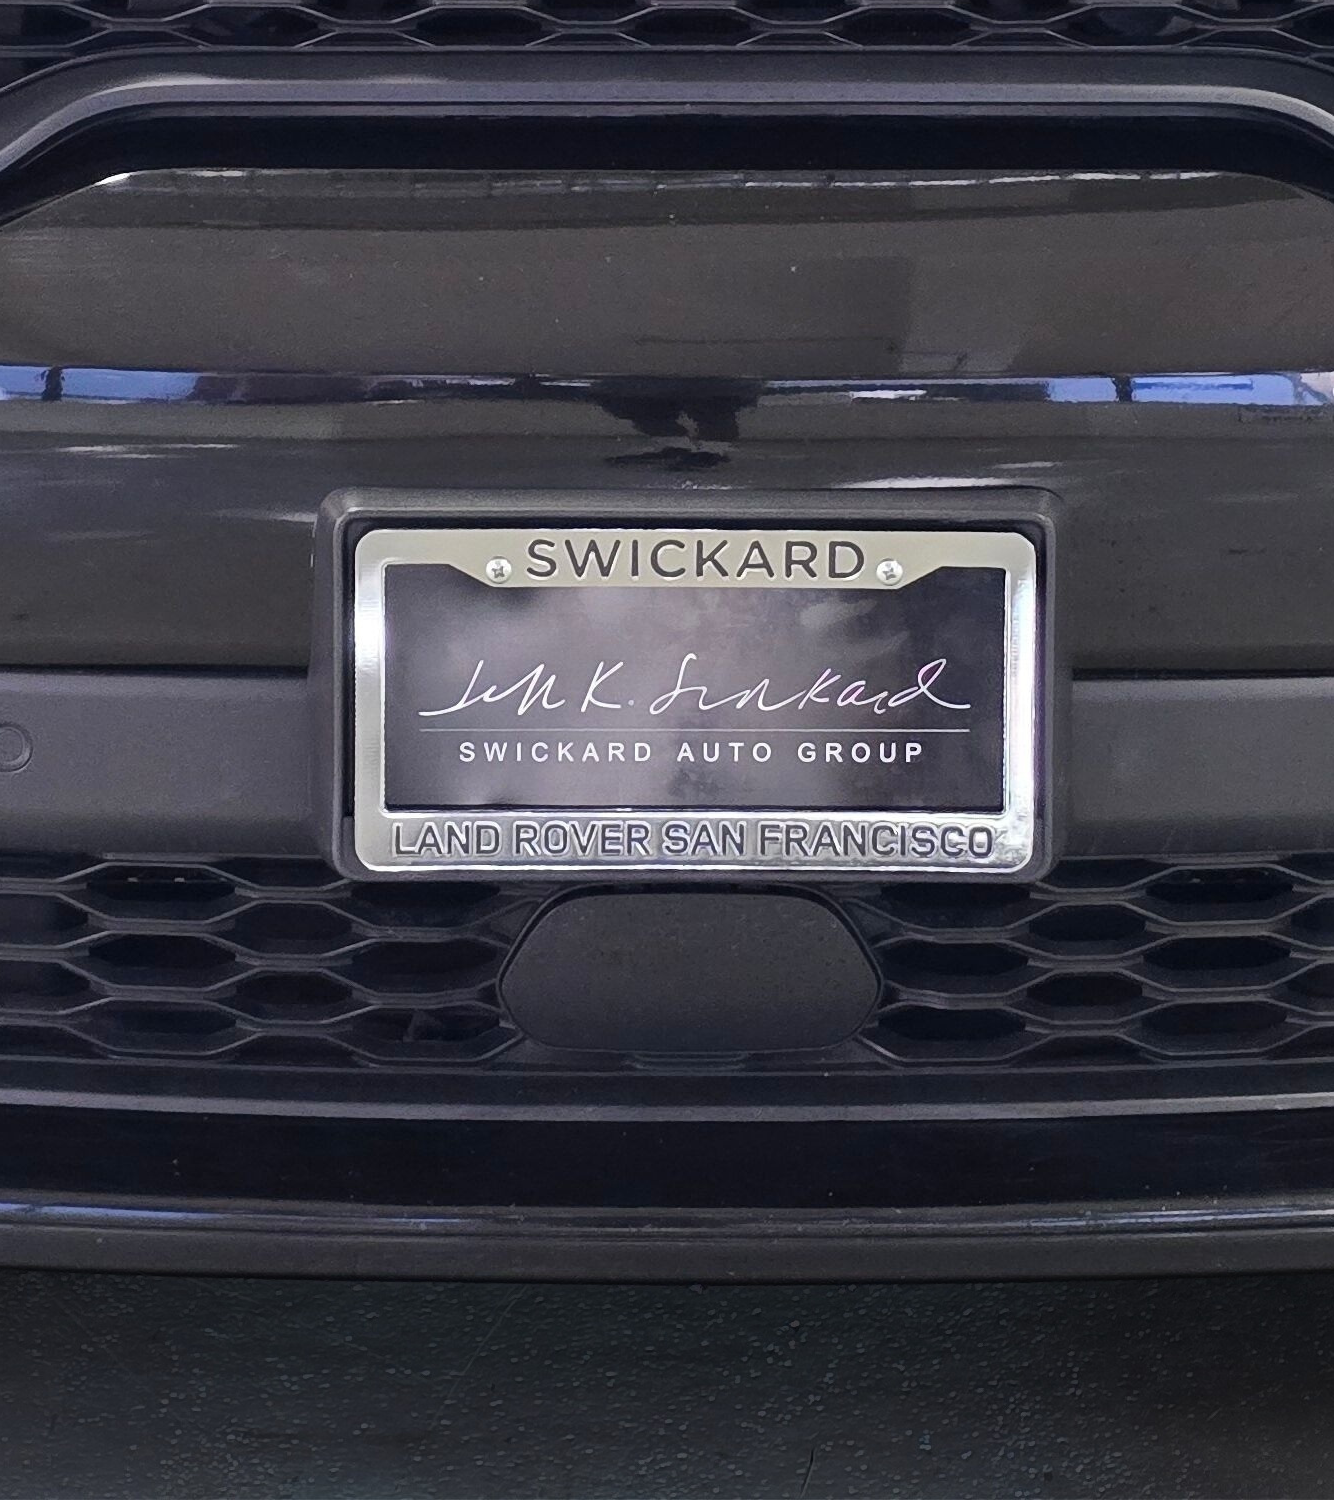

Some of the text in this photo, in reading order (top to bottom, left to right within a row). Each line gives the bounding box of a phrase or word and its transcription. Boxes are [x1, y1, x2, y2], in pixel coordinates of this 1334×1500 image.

[526, 538, 866, 579] SWICKARD
[458, 741, 923, 763] SWICKARD AUTO GROUP
[394, 822, 994, 859] LAND ROVER SAN FRANCISCO
